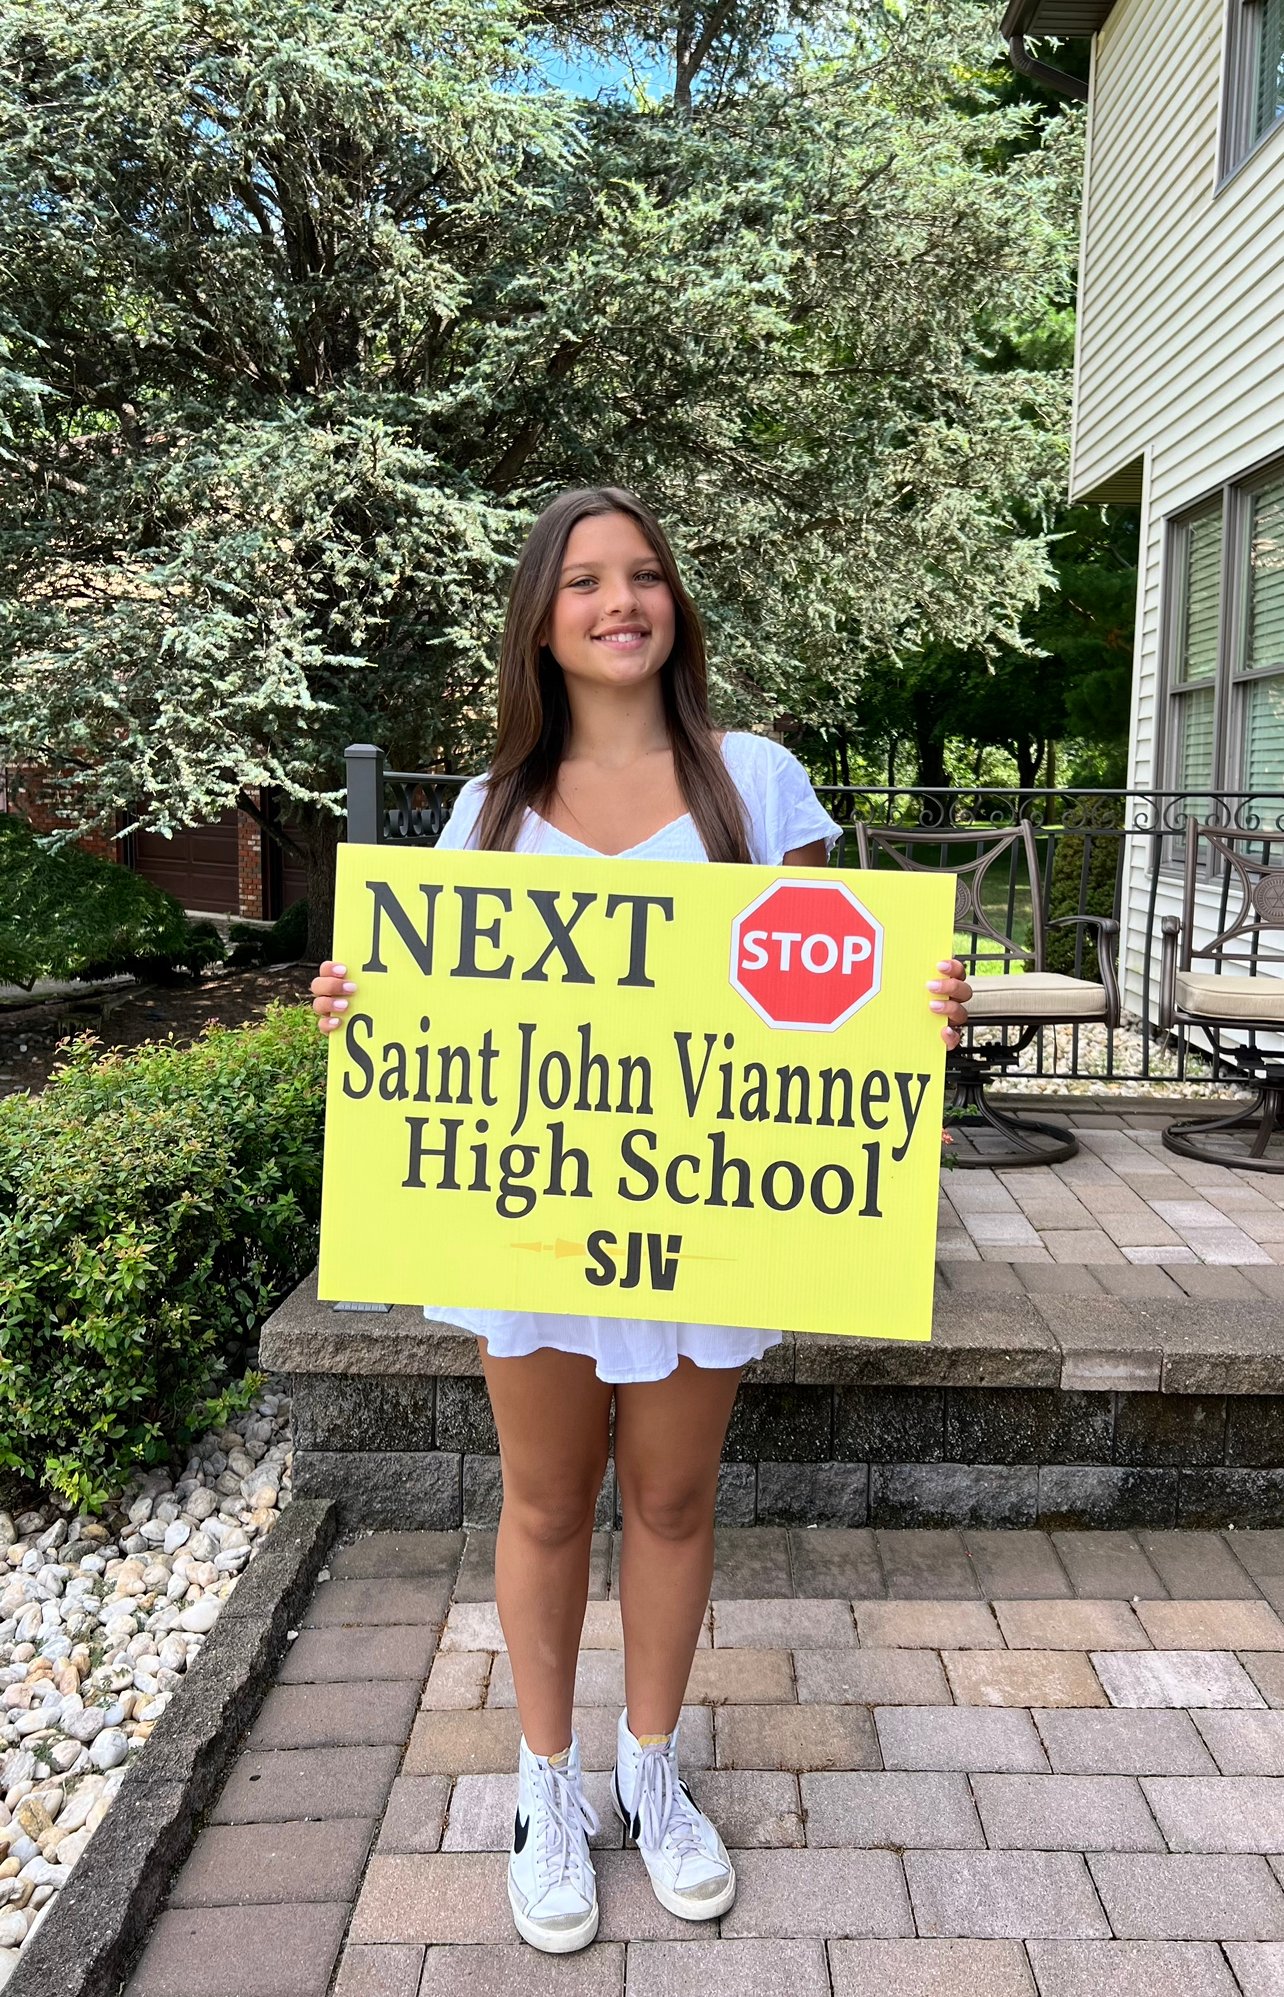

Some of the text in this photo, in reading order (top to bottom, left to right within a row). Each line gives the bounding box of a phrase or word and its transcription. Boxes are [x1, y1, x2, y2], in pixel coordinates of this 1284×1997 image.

[362, 881, 872, 988] NEXT STOP
[342, 1013, 931, 1162] Saint John Vianney
[402, 1117, 883, 1219] High School
[585, 1230, 682, 1291] SJV
